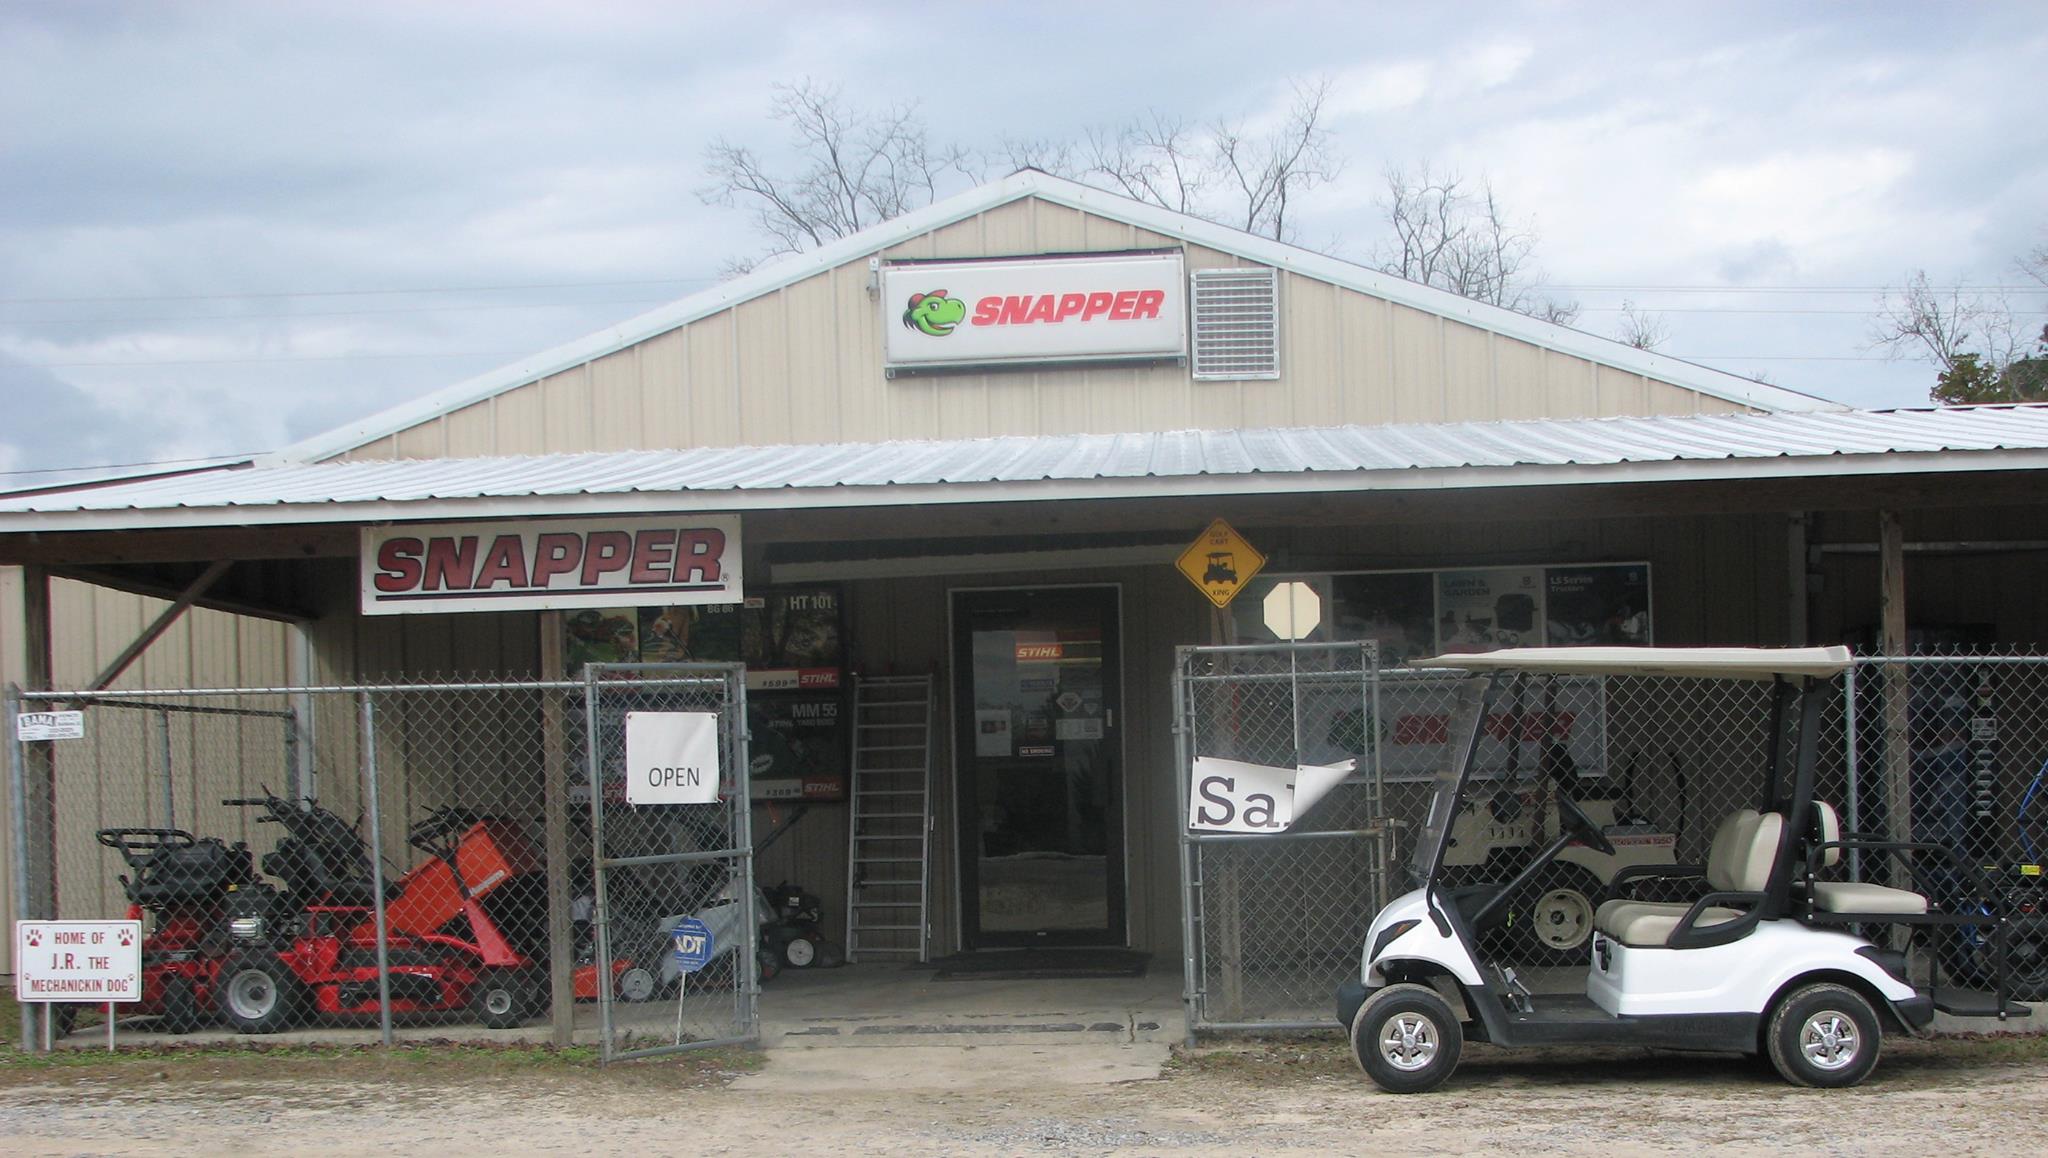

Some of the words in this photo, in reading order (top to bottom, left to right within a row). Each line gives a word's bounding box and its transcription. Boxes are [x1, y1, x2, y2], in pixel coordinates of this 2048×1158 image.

[971, 289, 1165, 327] SNAPPER
[374, 528, 726, 592] SNAPPER
[1212, 589, 1230, 597] XING
[790, 595, 808, 610] HT
[811, 595, 831, 609] 101
[1017, 647, 1060, 658] STIHL
[800, 673, 836, 684] STIHL
[792, 703, 820, 718] MM
[822, 703, 838, 717] 55
[649, 767, 700, 787] OPEN
[805, 782, 841, 793] STIHL
[55, 932, 86, 945] HOME
[91, 932, 106, 945] OF
[51, 953, 81, 970] J.R.
[88, 957, 111, 970] THE
[31, 979, 103, 993] MECHANICKIN
[107, 979, 129, 993] DOG
